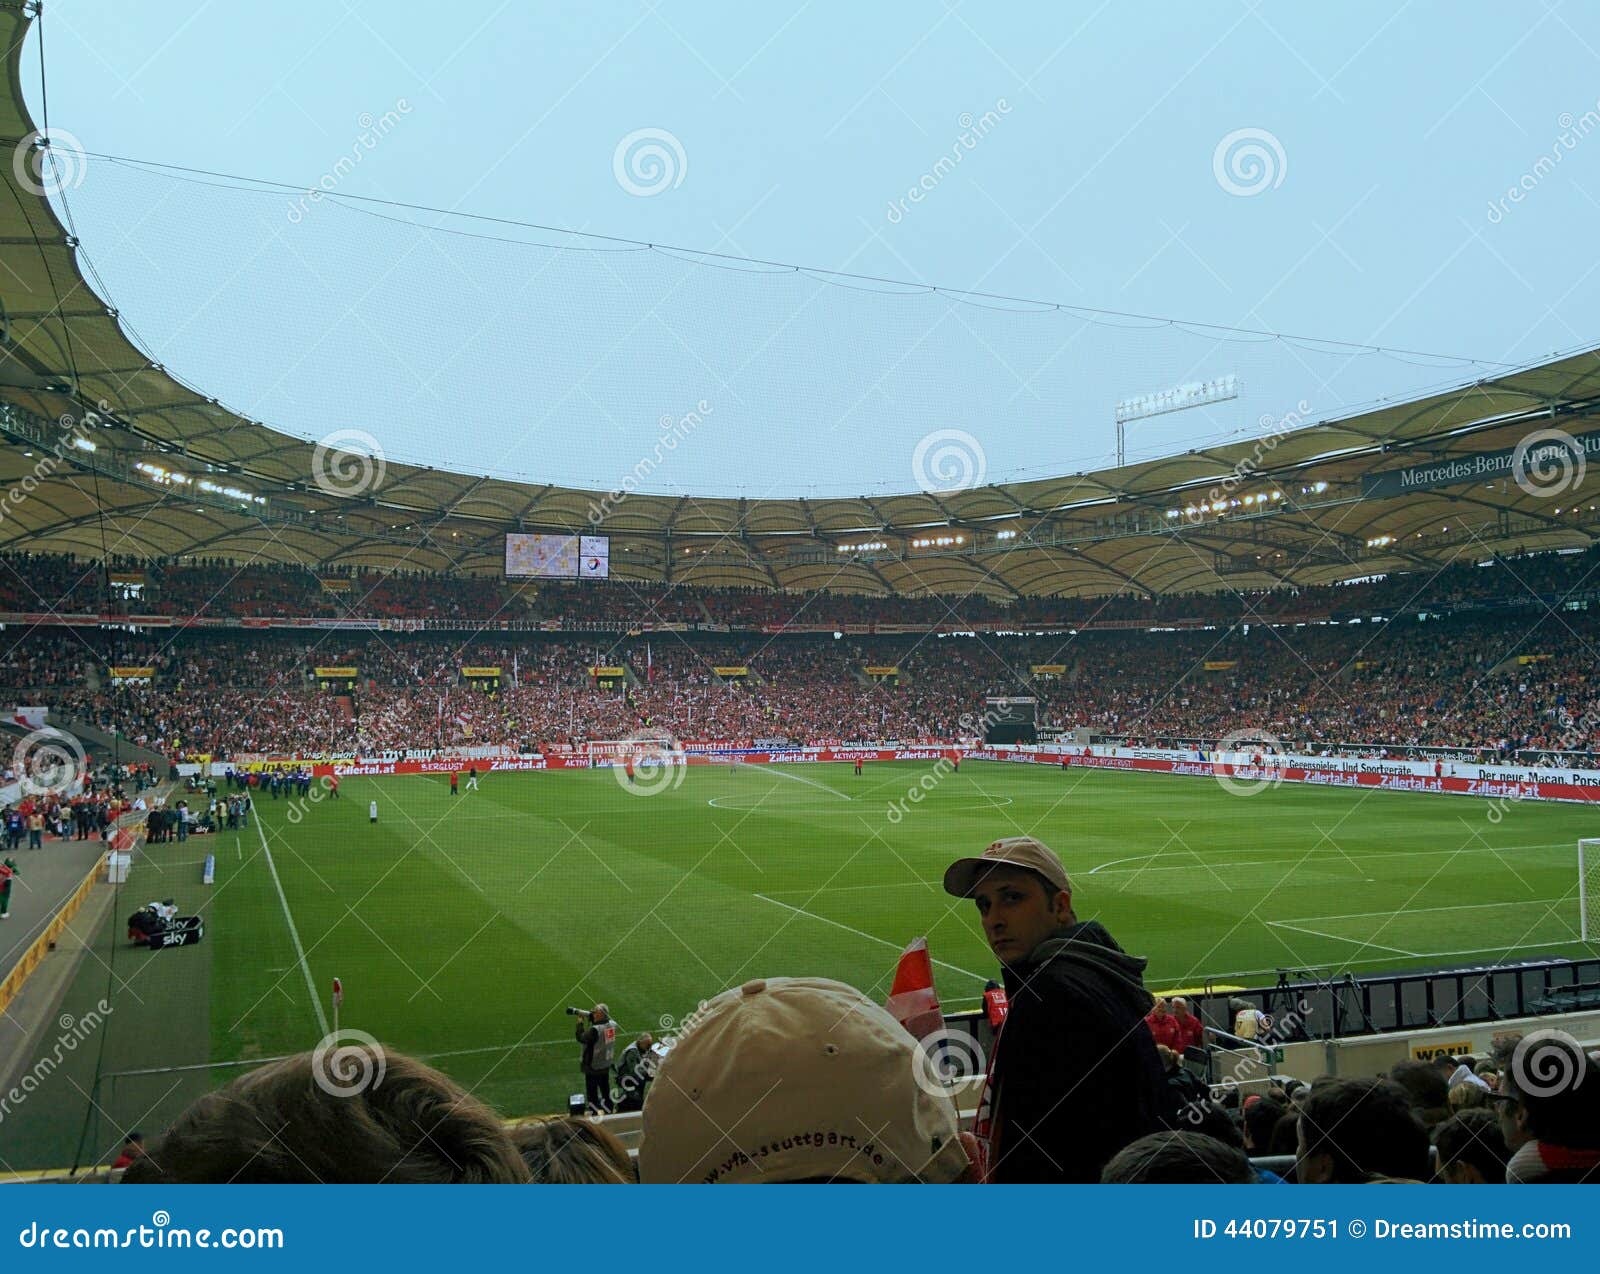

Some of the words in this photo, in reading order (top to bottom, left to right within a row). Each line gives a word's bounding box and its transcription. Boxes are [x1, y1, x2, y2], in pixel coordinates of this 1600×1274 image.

[1400, 454, 1514, 487] Mercedes-Benz
[1518, 445, 1569, 467] Arena
[768, 752, 819, 763] Zillertal.at
[894, 750, 941, 760] Zillertal.at
[1133, 751, 1188, 762] PORSCHE
[1418, 750, 1478, 763] Mercedes-Benz
[333, 764, 396, 776] Zillertal.at
[490, 759, 548, 771] Zillertal.at
[1171, 761, 1214, 775] Zillertal.at
[1342, 759, 1359, 773] Und
[1303, 770, 1359, 785] Zillertal.at
[1379, 775, 1443, 791] Zillertal.at
[1478, 769, 1497, 780] Der
[1499, 772, 1524, 783] neue
[1527, 771, 1569, 785] Macan.
[1467, 780, 1541, 798] Zillertal.at
[163, 932, 188, 945] sky
